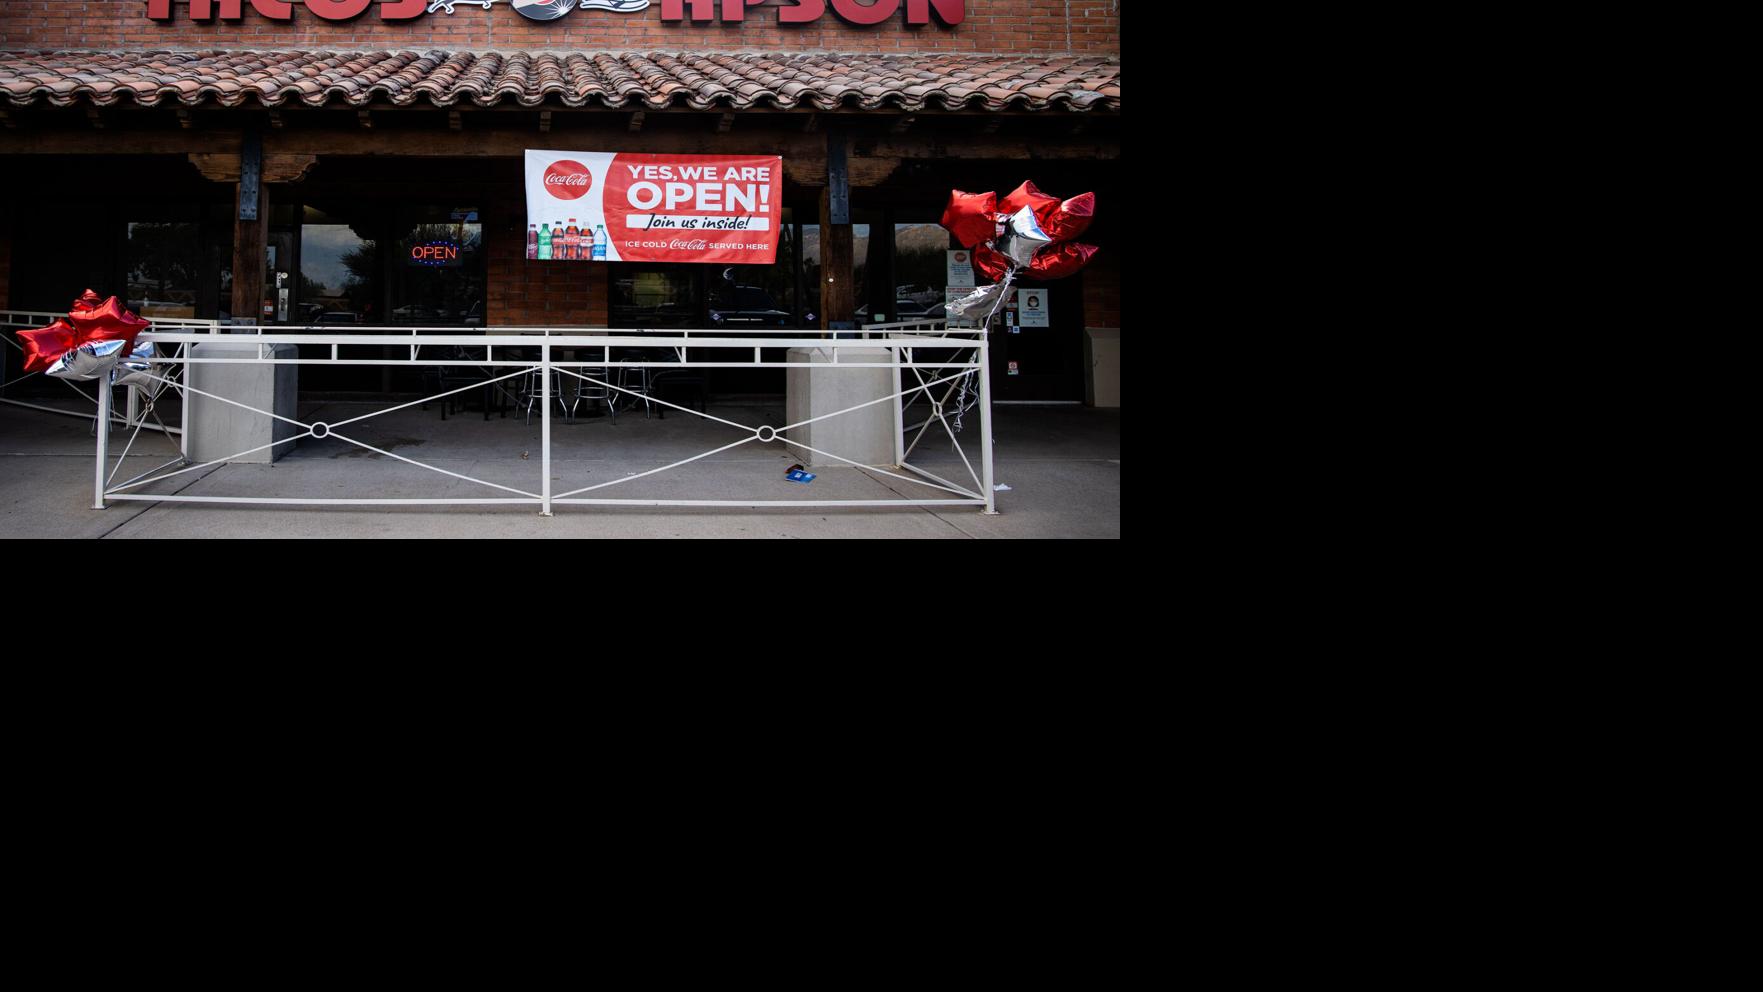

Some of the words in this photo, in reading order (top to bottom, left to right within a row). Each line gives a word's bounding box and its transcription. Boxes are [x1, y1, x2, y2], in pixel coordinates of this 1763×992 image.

[627, 165, 677, 181] YES,
[678, 166, 718, 180] WE
[723, 167, 770, 181] ARE
[627, 181, 770, 213] OPEN!
[643, 213, 675, 231] Join
[681, 217, 698, 229] us
[702, 214, 752, 230] inside!
[412, 246, 456, 259] OPEN
[709, 242, 744, 250] SERVED
